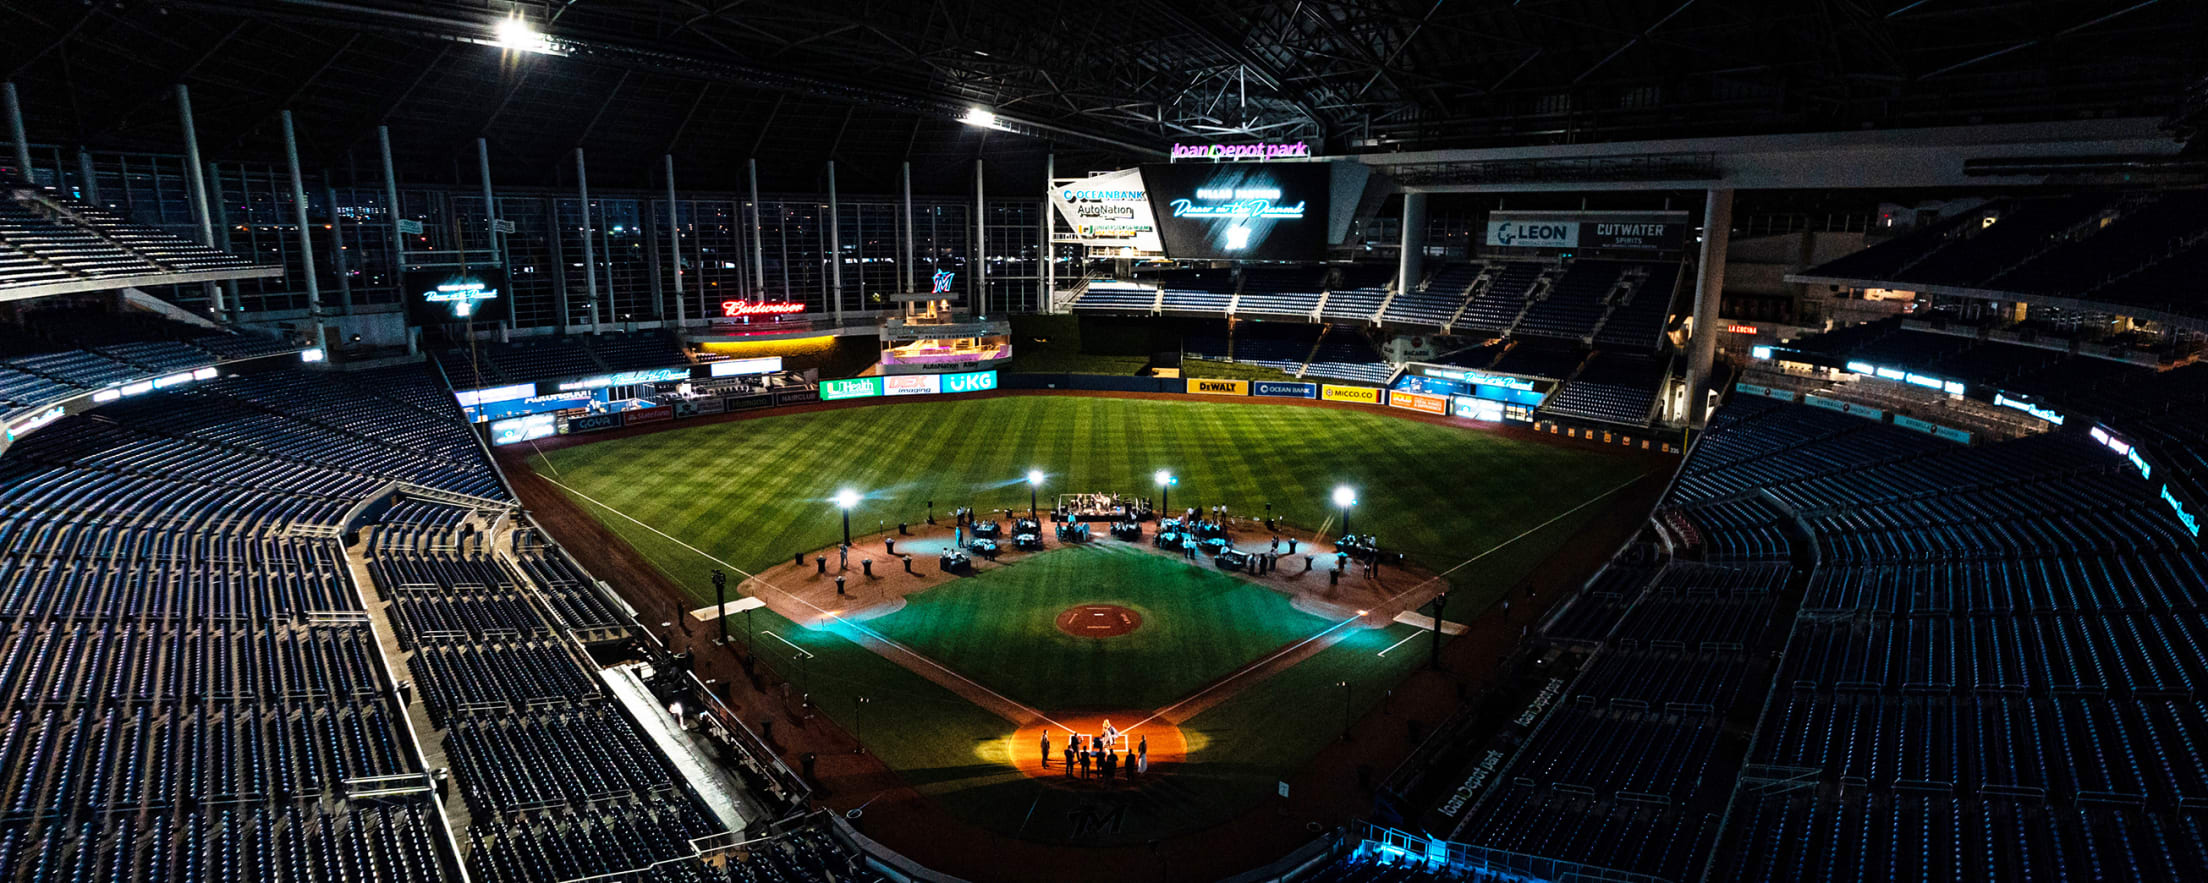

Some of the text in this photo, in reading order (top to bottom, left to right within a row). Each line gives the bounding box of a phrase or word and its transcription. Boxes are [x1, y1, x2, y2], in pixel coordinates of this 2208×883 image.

[1173, 141, 1308, 161] loanDepot park
[1078, 205, 1133, 214] AutoNation
[1518, 225, 1567, 240] LEON
[1597, 223, 1664, 236] CUTWATER
[722, 300, 805, 317] Budweiser
[922, 362, 959, 370] AutoNation
[889, 375, 927, 388] DEX
[1334, 390, 1373, 399] MICCO.CO
[1436, 749, 1504, 818] loanDepot park
